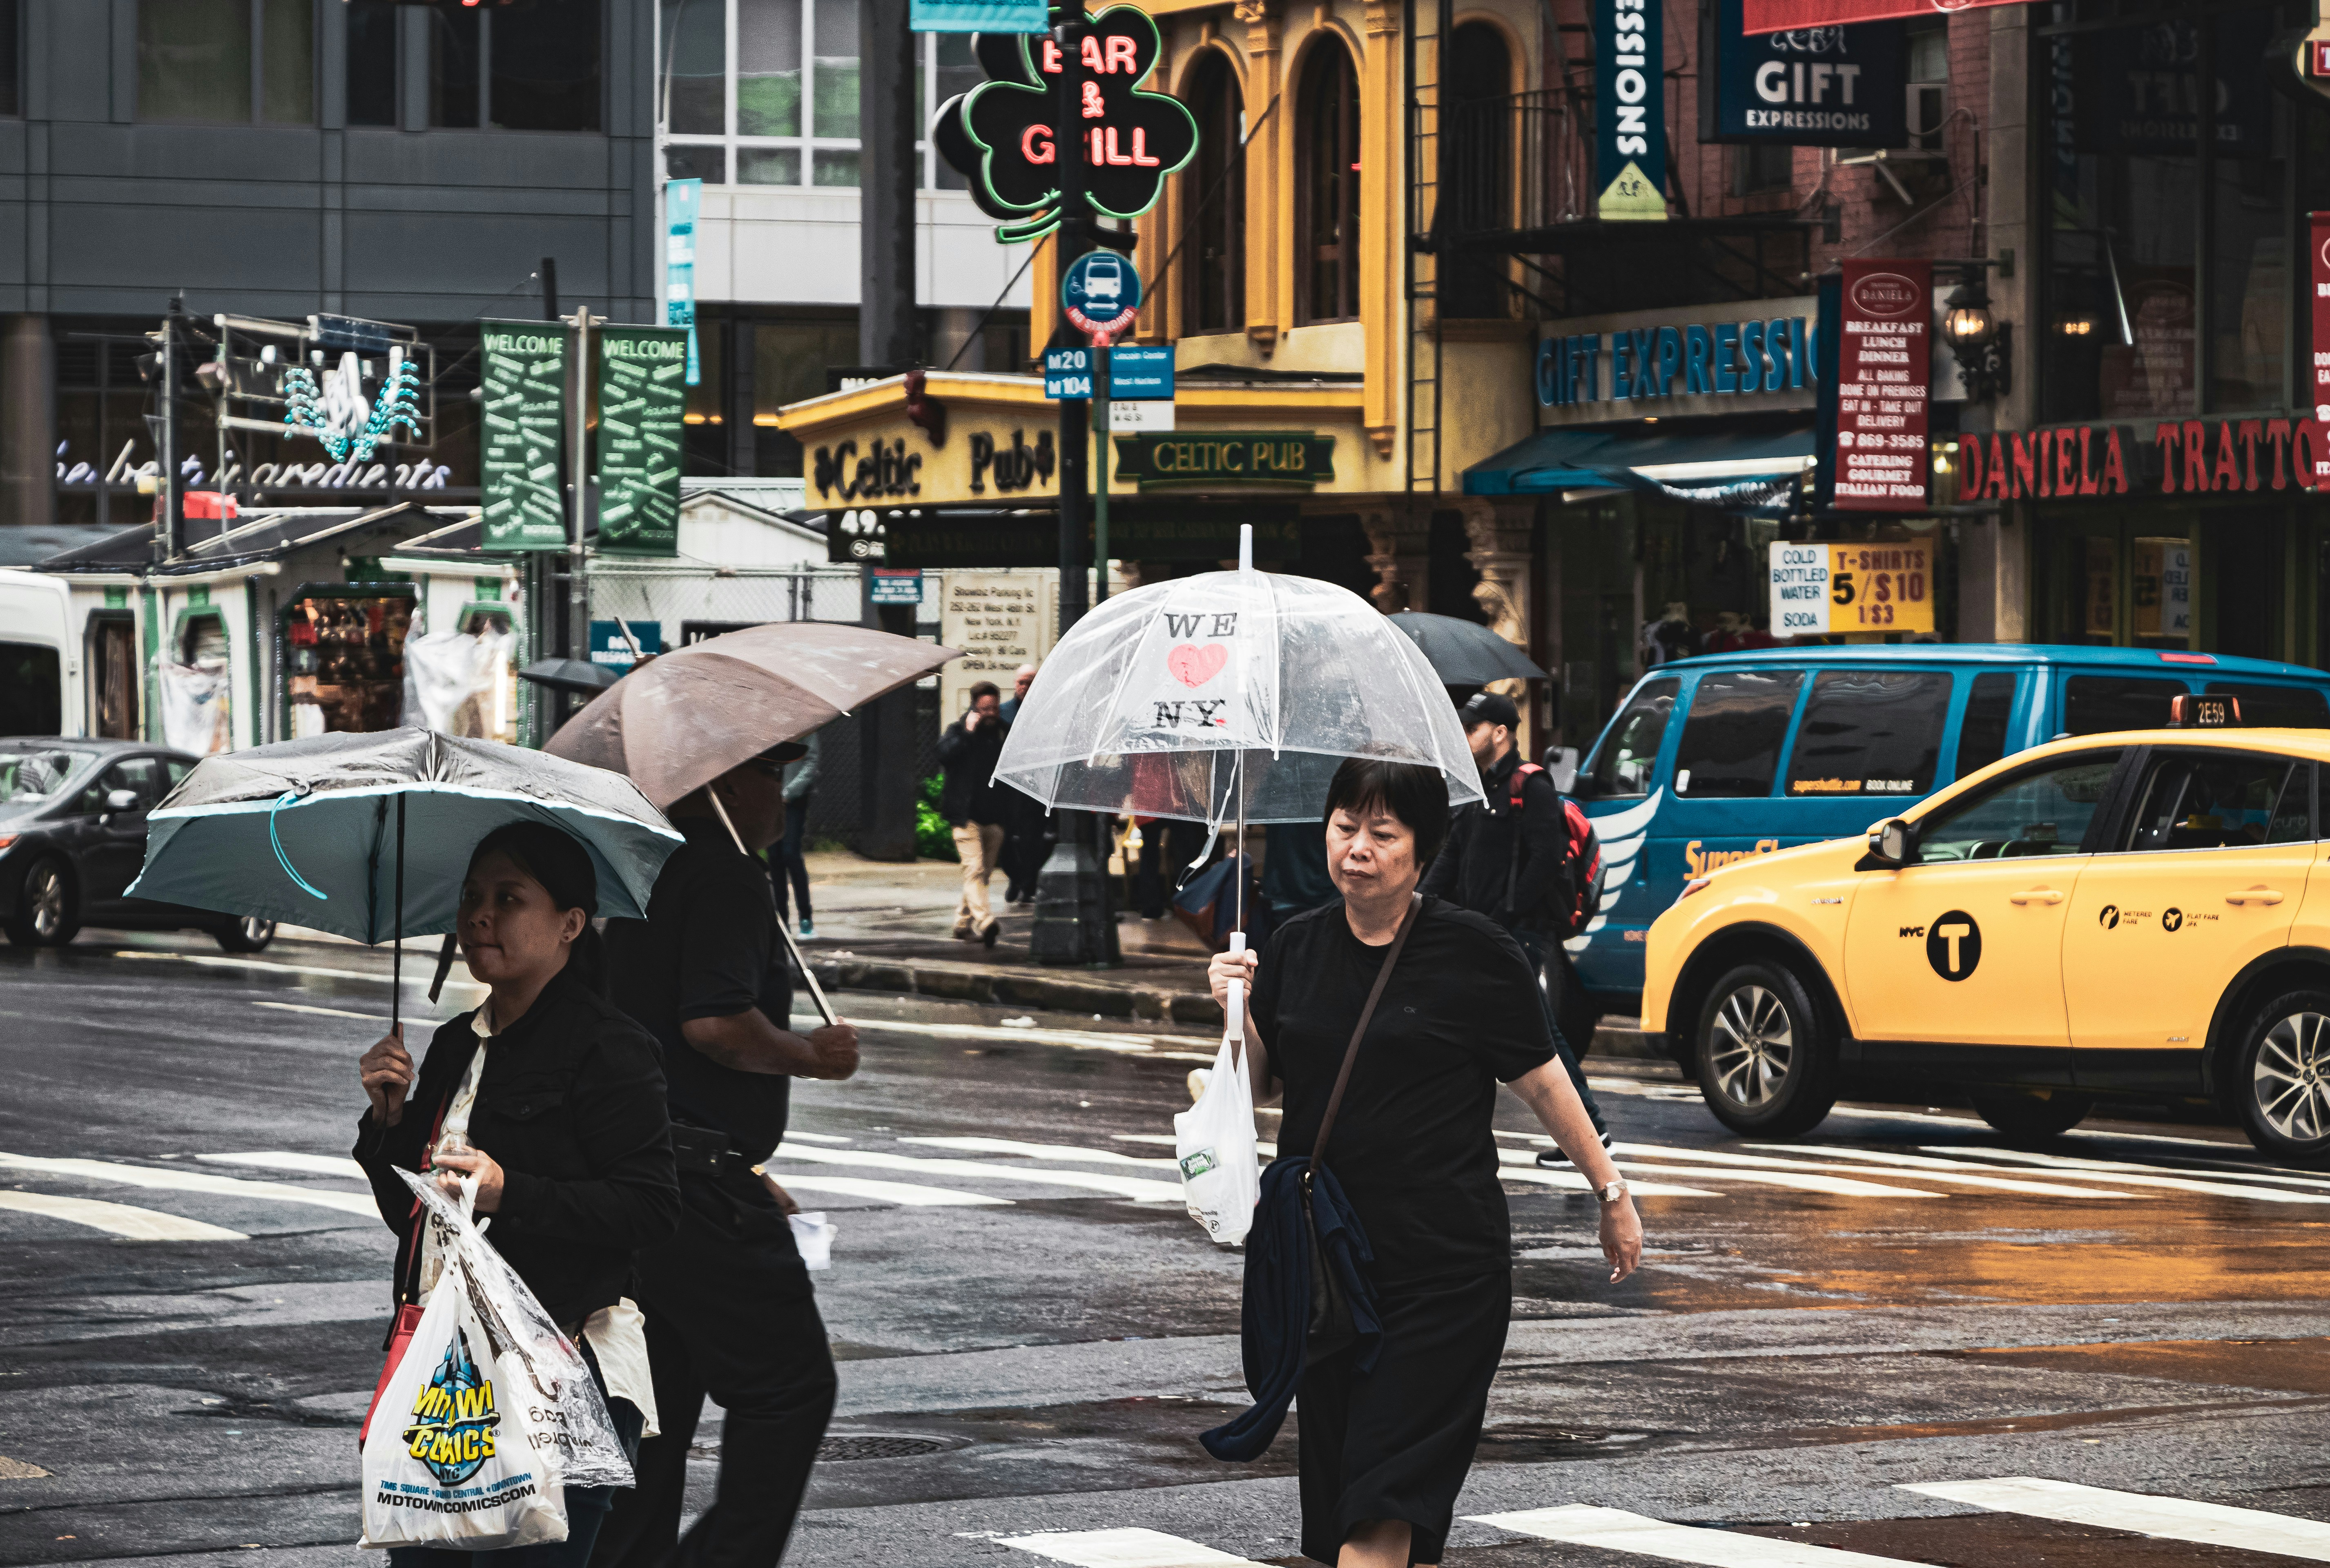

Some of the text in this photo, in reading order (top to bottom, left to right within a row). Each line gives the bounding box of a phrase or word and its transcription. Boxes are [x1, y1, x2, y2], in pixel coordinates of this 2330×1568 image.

[1755, 60, 1861, 105] GIFT
[1746, 109, 1870, 130] EXPRESSIONS
[1021, 124, 1160, 166] GILL
[1861, 289, 1912, 300] DANIELA
[1070, 308, 1135, 331] NO STANDING
[1845, 321, 1924, 334] BREAKFAST
[484, 334, 564, 355] WELCOME
[603, 339, 685, 359] WELCOME
[1862, 336, 1907, 348] LUNCH
[1048, 350, 1086, 369] M20
[1536, 317, 1818, 406] GIFT EXPRESSI
[1858, 350, 1909, 362] DINNER
[1858, 369, 1874, 381] ALL
[1048, 376, 1090, 395] M104
[1839, 383, 1864, 395] DONE
[1881, 385, 1926, 397] PREMISES
[1842, 399, 1859, 411] EAT
[1857, 414, 1906, 427] DELIVERY
[1857, 433, 1924, 448] 869-3585
[1153, 441, 1307, 473] CELTIC PUB
[1847, 454, 1914, 467] CATERING
[1960, 426, 2129, 500] DANIELA
[832, 428, 1035, 502] Celtic Pub
[1848, 468, 1912, 482] GOURMET
[1835, 483, 1925, 497] ITALIAN FOOD
[1783, 550, 1816, 564] COLD
[1837, 550, 1924, 571] T-SHIRTS
[1773, 568, 1828, 583] BOTTLED
[990, 587, 1022, 599] Parking
[1780, 585, 1821, 600] WATER
[965, 617, 981, 626] New
[1164, 612, 1237, 638] WE
[1783, 612, 1818, 627] SODA
[2198, 702, 2225, 723] 2E59
[1899, 923, 1970, 972] NYC T
[439, 1467, 460, 1480] NYC
[400, 1483, 430, 1495] SQUARE
